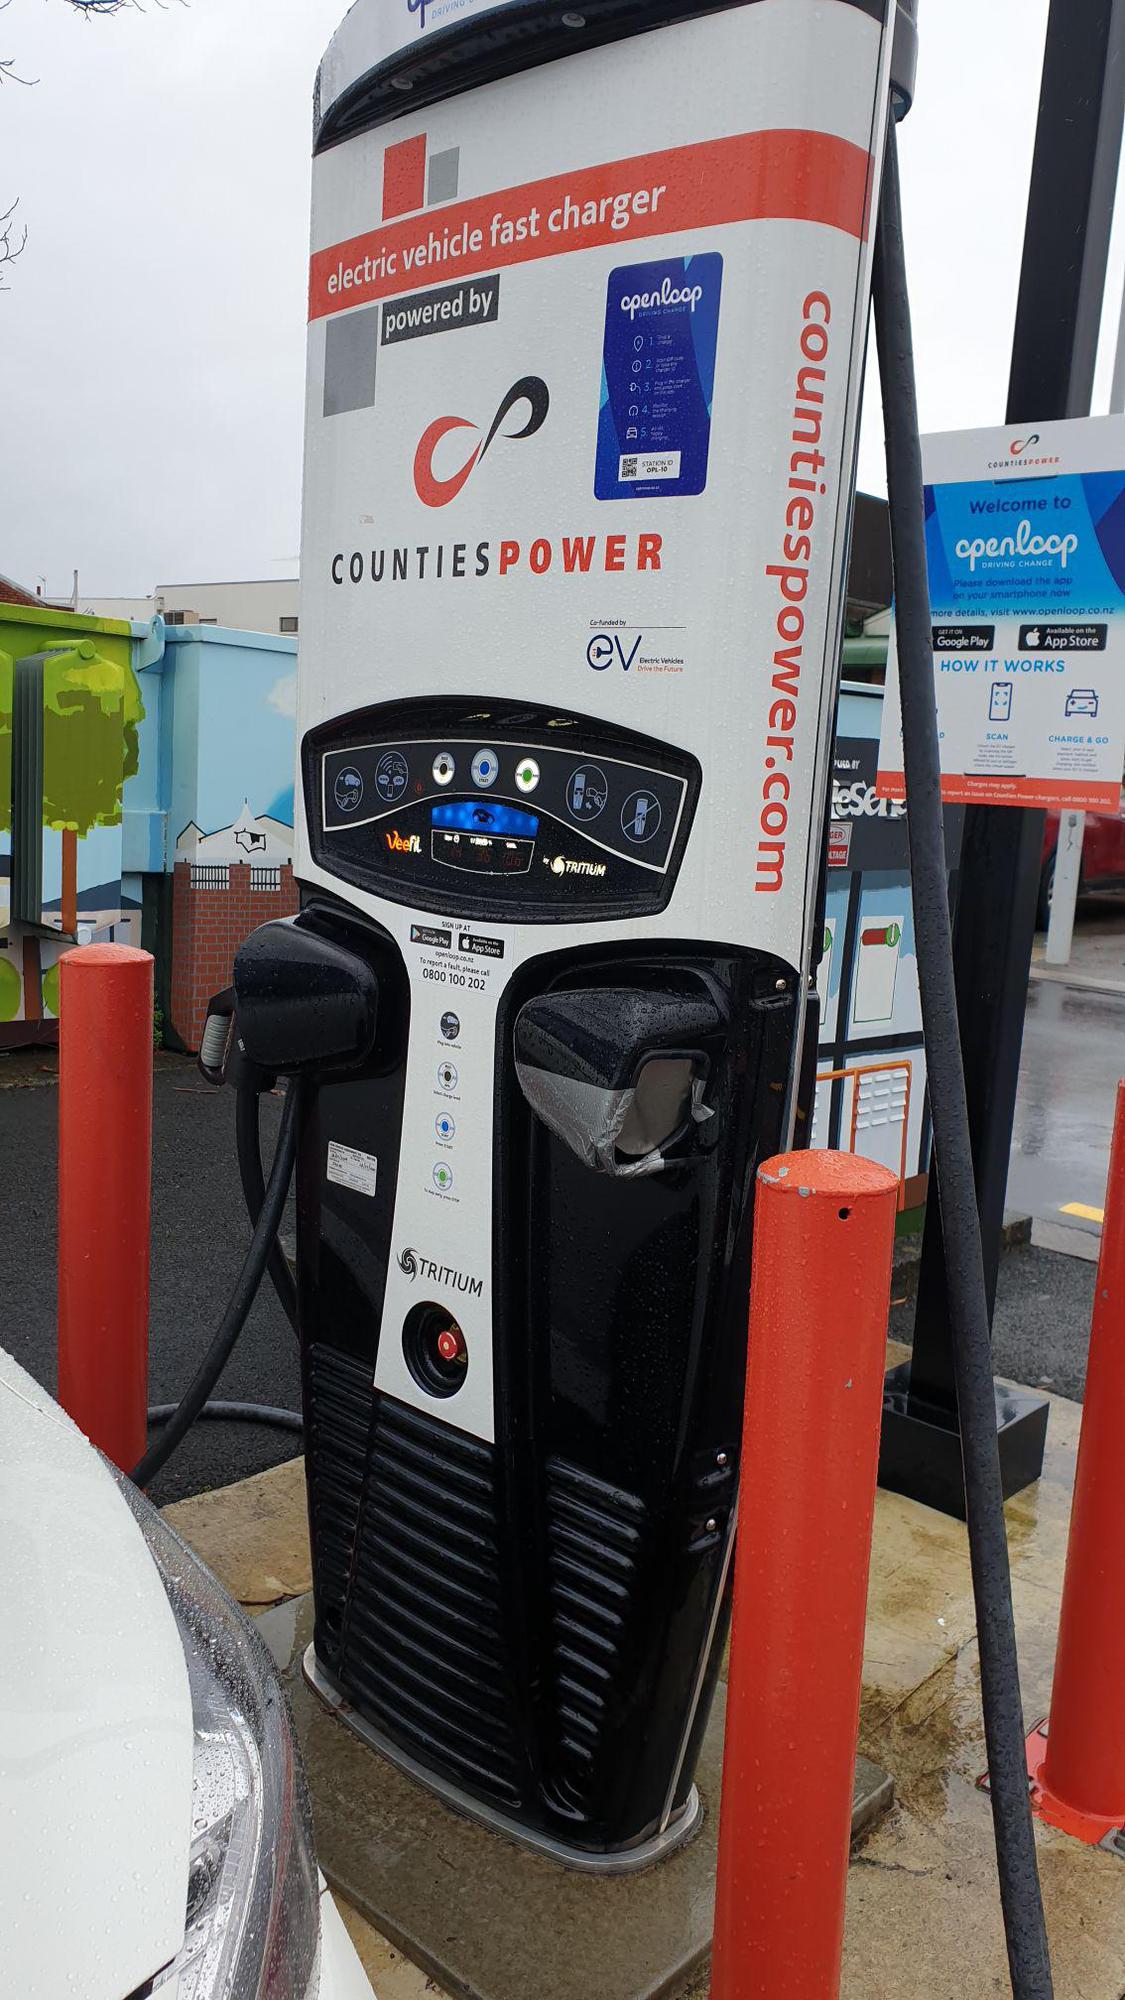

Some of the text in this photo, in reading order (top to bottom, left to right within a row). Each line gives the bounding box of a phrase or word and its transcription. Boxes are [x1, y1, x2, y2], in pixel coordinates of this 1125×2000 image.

[431, 2, 466, 19] DRIVING
[327, 185, 666, 294] electric vehicle fast charger
[620, 277, 703, 321] openloop
[385, 288, 492, 338] powered by
[987, 456, 1060, 469] COUNTIESPOWER
[969, 496, 1072, 515] Welcome to
[955, 519, 1079, 572] openloop
[331, 533, 663, 584] COUNTIESPOWER
[981, 559, 1053, 569] DRIVING CHANGE
[953, 576, 1073, 588] Please download the app
[754, 290, 832, 893] countiespower.com
[967, 591, 987, 601] your
[990, 588, 1048, 601] smartphone
[1051, 588, 1071, 597] now
[955, 608, 988, 618] details,
[990, 607, 1010, 617] visit
[1012, 606, 1115, 618] www.openloop.co.nz
[937, 636, 989, 649] Google Play
[1044, 635, 1099, 648] App Store
[660, 657, 684, 665] Vehicles
[940, 659, 1066, 673] HOW IT WORKS
[663, 665, 684, 673] Future
[986, 733, 1009, 741] SCAN
[1048, 735, 1084, 744] CHARGE
[1095, 736, 1109, 744] GO
[565, 860, 607, 877] TRITIUM
[441, 921, 454, 929] SIGN
[422, 933, 449, 946] Google Play
[471, 943, 501, 955] App Store
[435, 950, 474, 963] openloop.co.nz
[426, 959, 443, 969] report
[447, 962, 462, 971] fault,
[462, 965, 480, 975] please
[480, 968, 490, 976] call
[422, 968, 486, 991] 0800 100 202
[419, 1257, 483, 1298] TRITIUM
